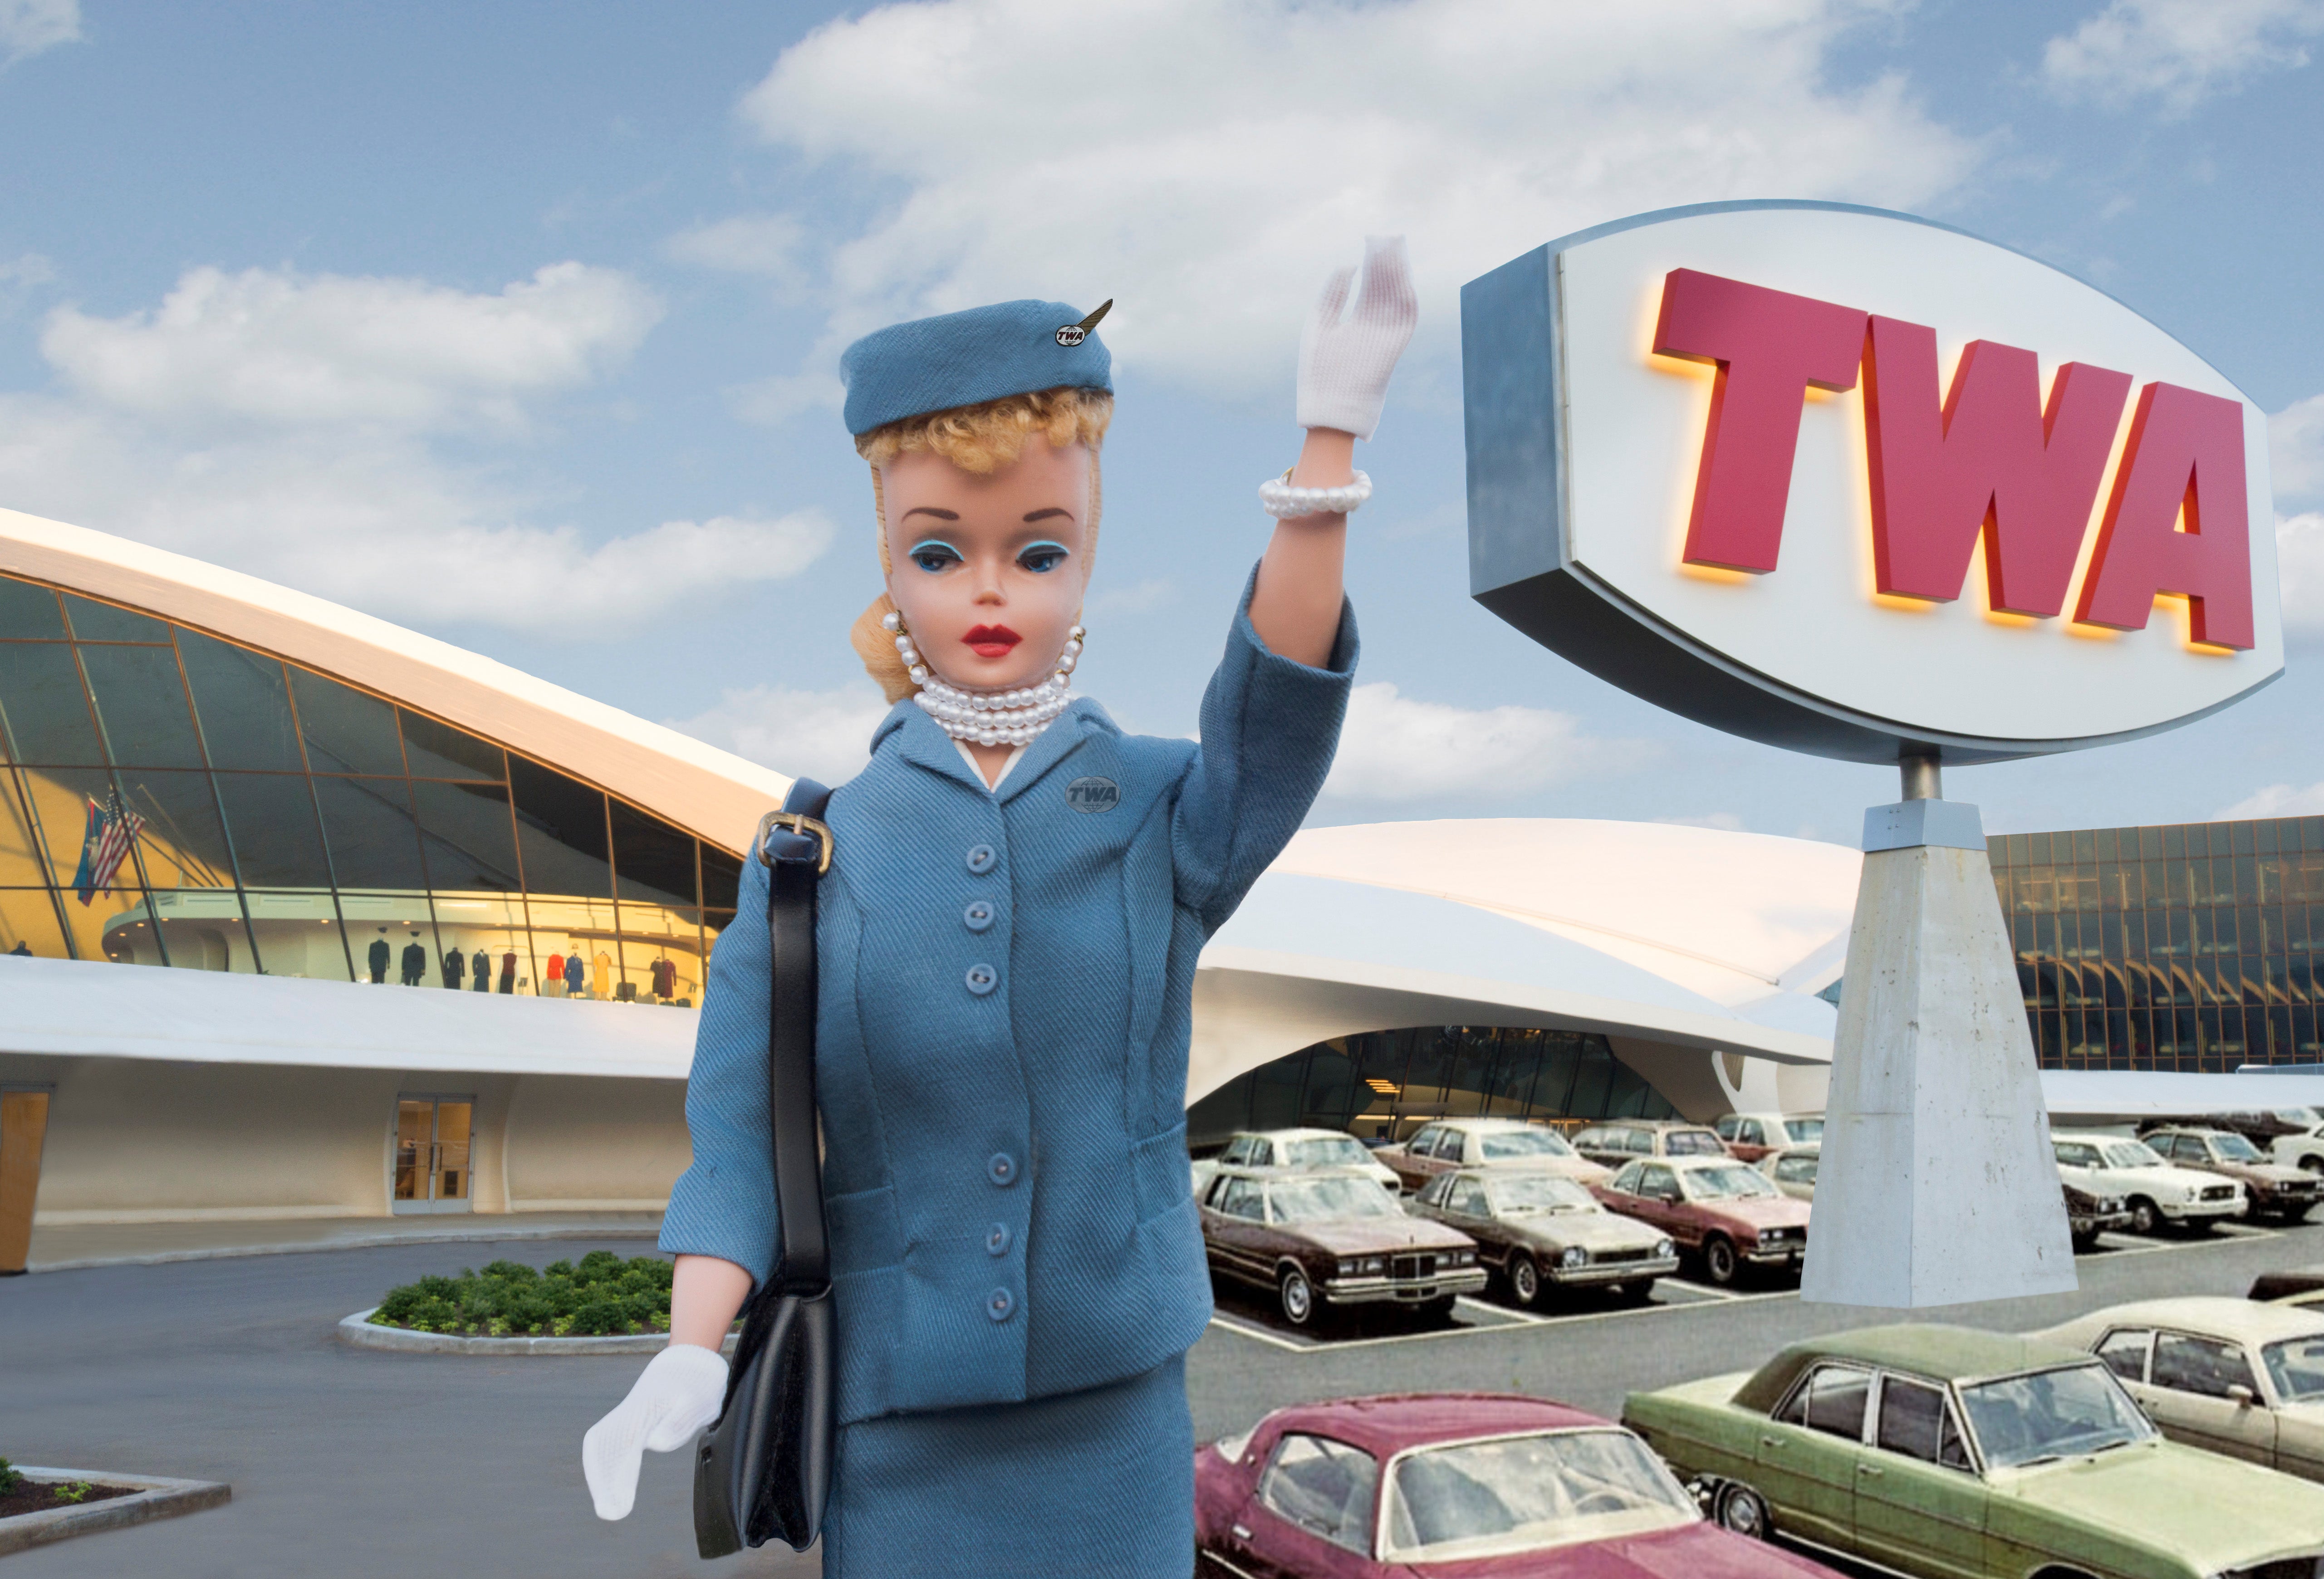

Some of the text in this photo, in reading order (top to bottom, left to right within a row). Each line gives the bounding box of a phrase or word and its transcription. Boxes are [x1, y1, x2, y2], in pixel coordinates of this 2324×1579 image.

[1058, 332, 1083, 340] TWA
[1652, 267, 2255, 651] TWA
[1069, 786, 1117, 802] TWA
